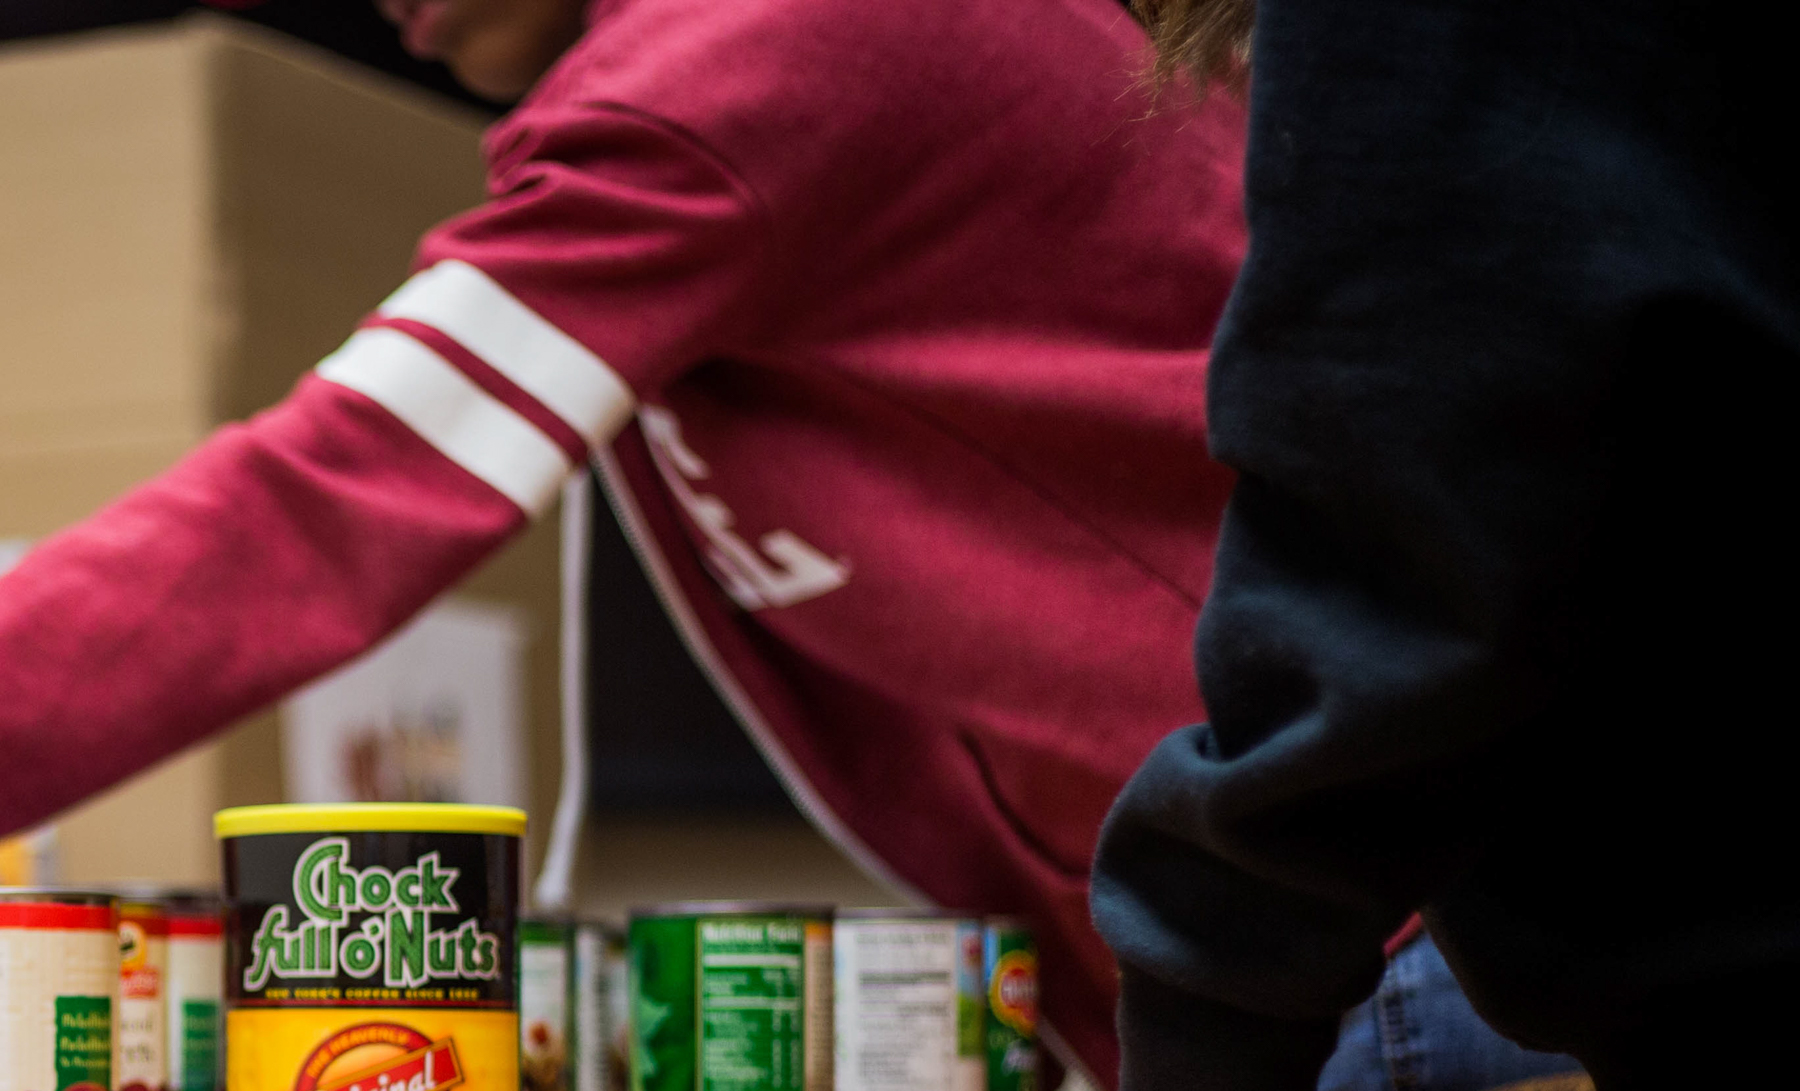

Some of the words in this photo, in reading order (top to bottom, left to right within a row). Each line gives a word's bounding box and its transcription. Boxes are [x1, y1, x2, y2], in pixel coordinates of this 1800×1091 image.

[293, 837, 460, 927] Chock
[243, 904, 339, 991] full
[345, 988, 399, 999] COFFEE
[405, 988, 444, 999] SINCE
